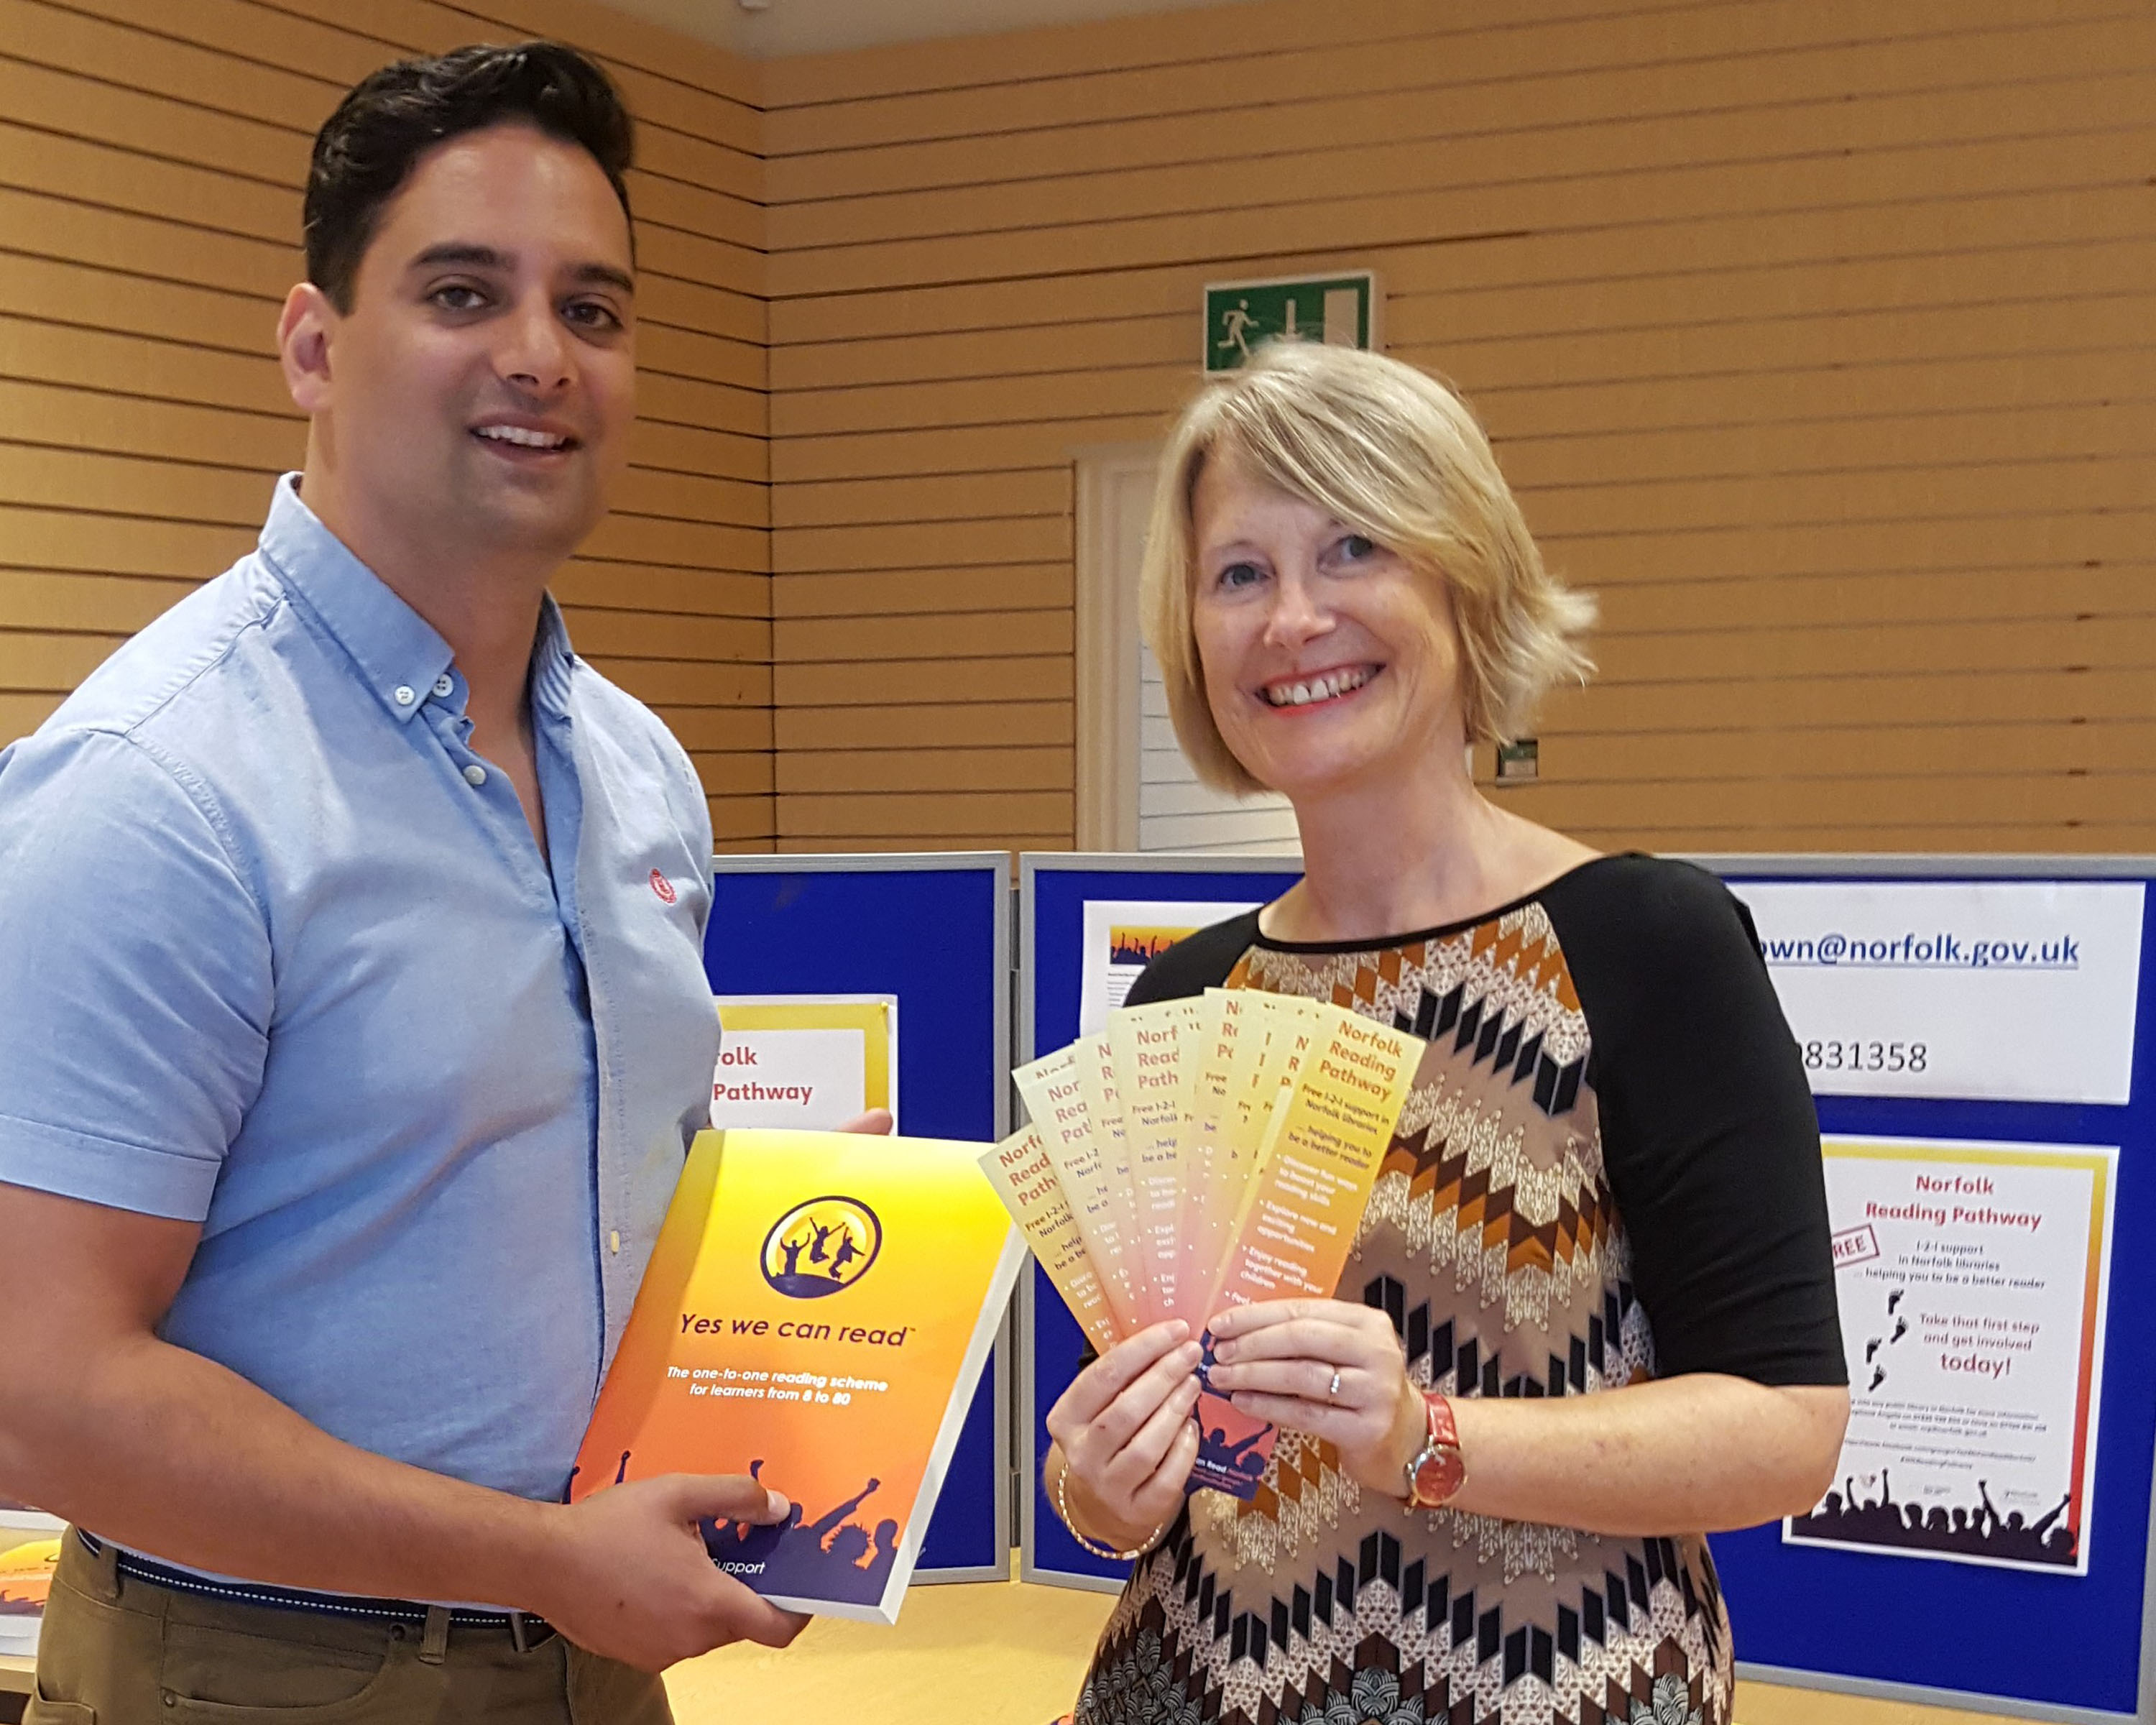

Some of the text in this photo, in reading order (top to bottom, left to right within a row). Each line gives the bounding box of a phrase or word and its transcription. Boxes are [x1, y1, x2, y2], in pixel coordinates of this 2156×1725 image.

[1338, 1019, 1404, 1059] Norfolk
[719, 1046, 757, 1066] olk
[1329, 1039, 1397, 1082] Reading
[1319, 1058, 1392, 1103] Pathway
[713, 1082, 814, 1106] Pathway
[1018, 1174, 1059, 1206] Path
[1915, 1174, 1994, 1196] Norfolk
[1865, 1202, 2042, 1233] Reading Pathway
[1940, 1244, 1984, 1256] support
[1898, 1255, 2001, 1272] in Norfolk libraries
[1866, 1266, 1906, 1283] helping
[1909, 1271, 1930, 1283] you
[1932, 1271, 1943, 1282] to
[1945, 1272, 1960, 1284] be
[1971, 1273, 2006, 1287] better
[2008, 1276, 2046, 1290] reader
[680, 1313, 724, 1335] Yes
[731, 1317, 770, 1337] we
[778, 1320, 831, 1341] can
[1920, 1313, 2040, 1336] Take that first step
[1923, 1332, 2032, 1352] and get involved
[1940, 1353, 2011, 1379] today!
[667, 1366, 890, 1393] The one-to-one reading scheme
[689, 1383, 851, 1407] for learners from 8 to 80
